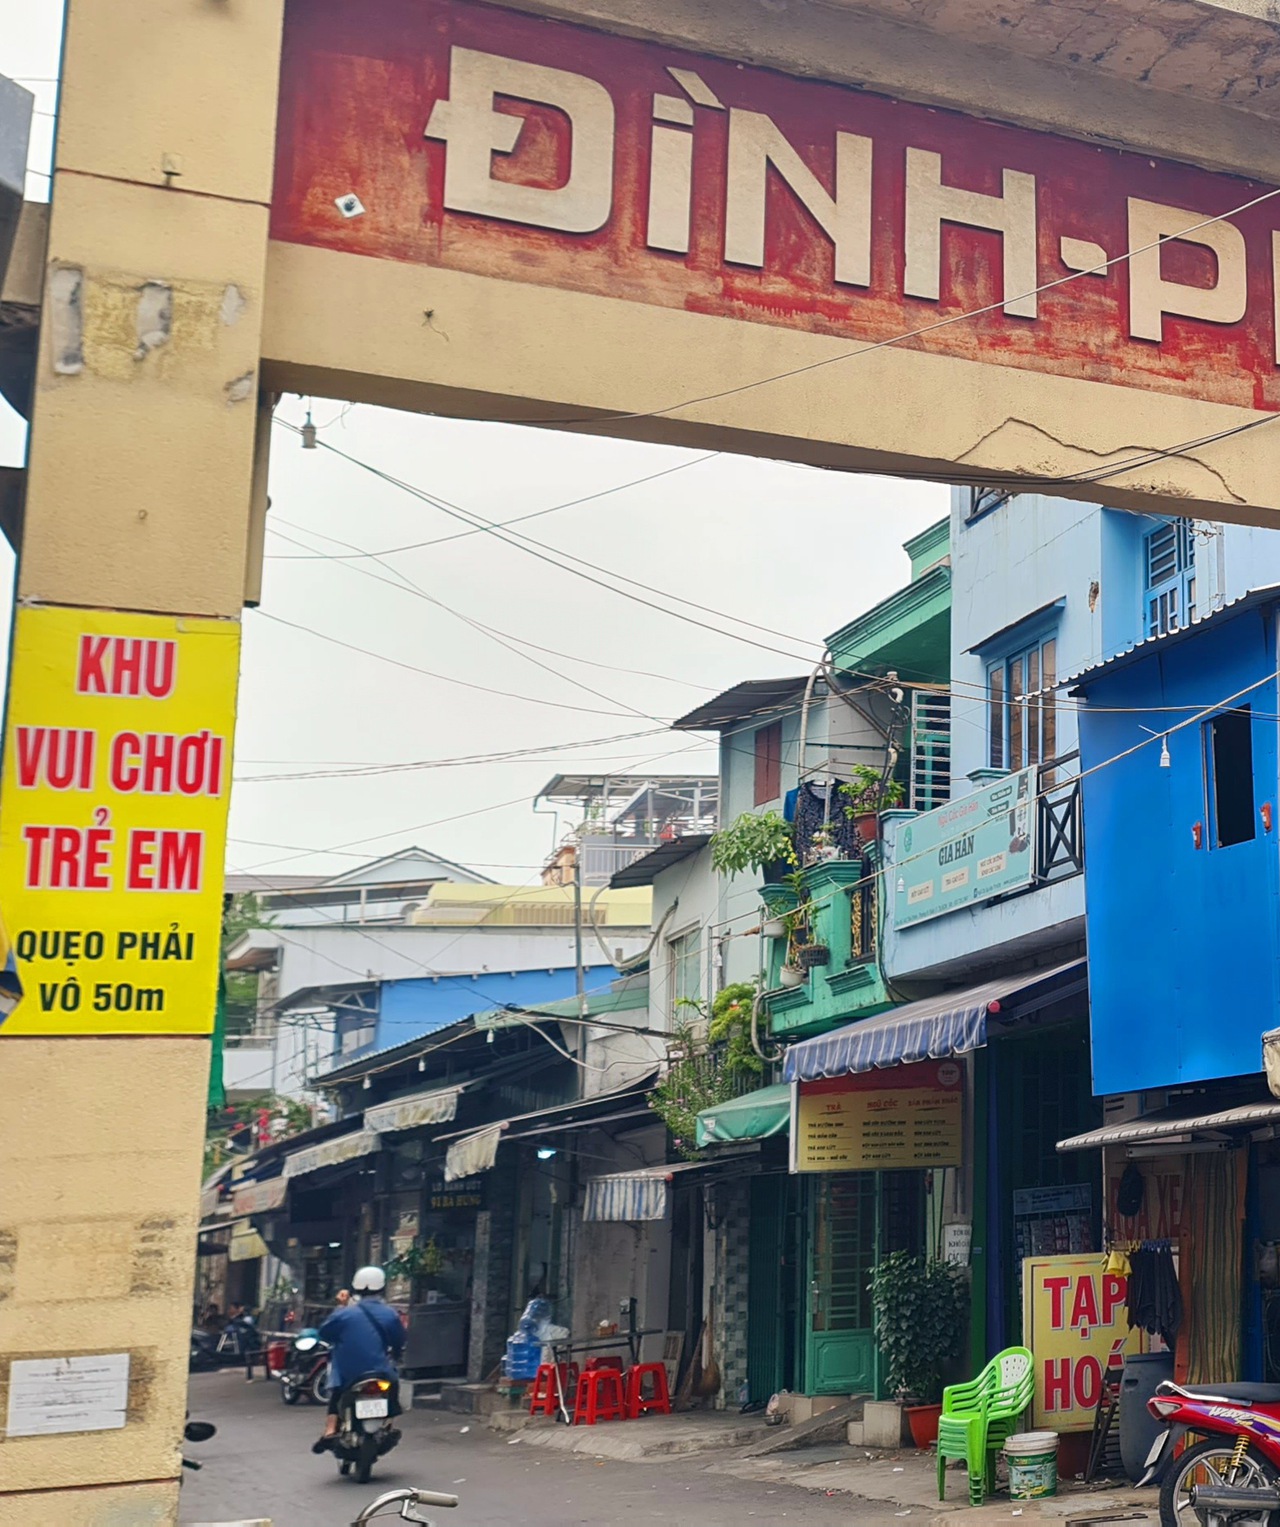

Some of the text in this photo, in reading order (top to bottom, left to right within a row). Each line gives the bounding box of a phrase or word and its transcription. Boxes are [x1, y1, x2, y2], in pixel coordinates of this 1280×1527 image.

[77, 634, 175, 698] KHU
[16, 726, 224, 795] VUI CHƠI
[23, 806, 204, 890] TRẺ EM
[938, 844, 953, 866] GIA
[16, 921, 195, 967] QUẸO PHẢI
[38, 976, 165, 1012] VÔ 50m
[1154, 1174, 1180, 1239] XE
[1042, 1273, 1128, 1338] TẠP
